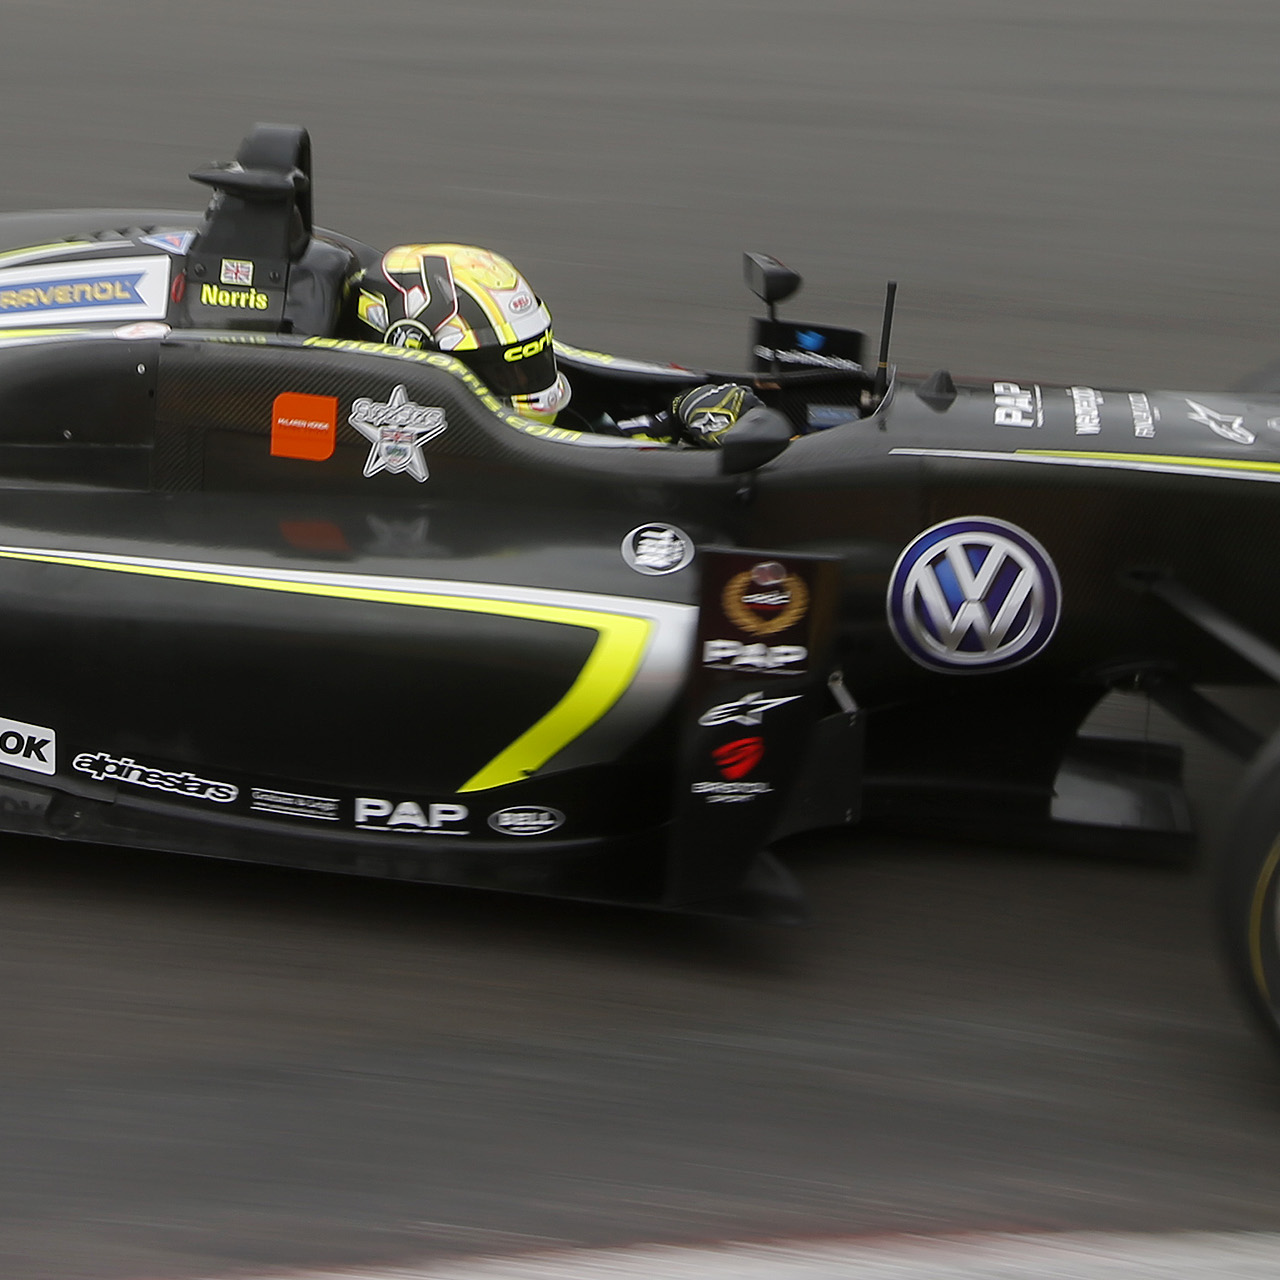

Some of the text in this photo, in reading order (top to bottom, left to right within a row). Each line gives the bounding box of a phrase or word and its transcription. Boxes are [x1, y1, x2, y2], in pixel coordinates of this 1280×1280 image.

[201, 283, 268, 310] Norris
[703, 638, 808, 669] PAP
[72, 752, 239, 803] alpinestars
[355, 798, 469, 828] PAP
